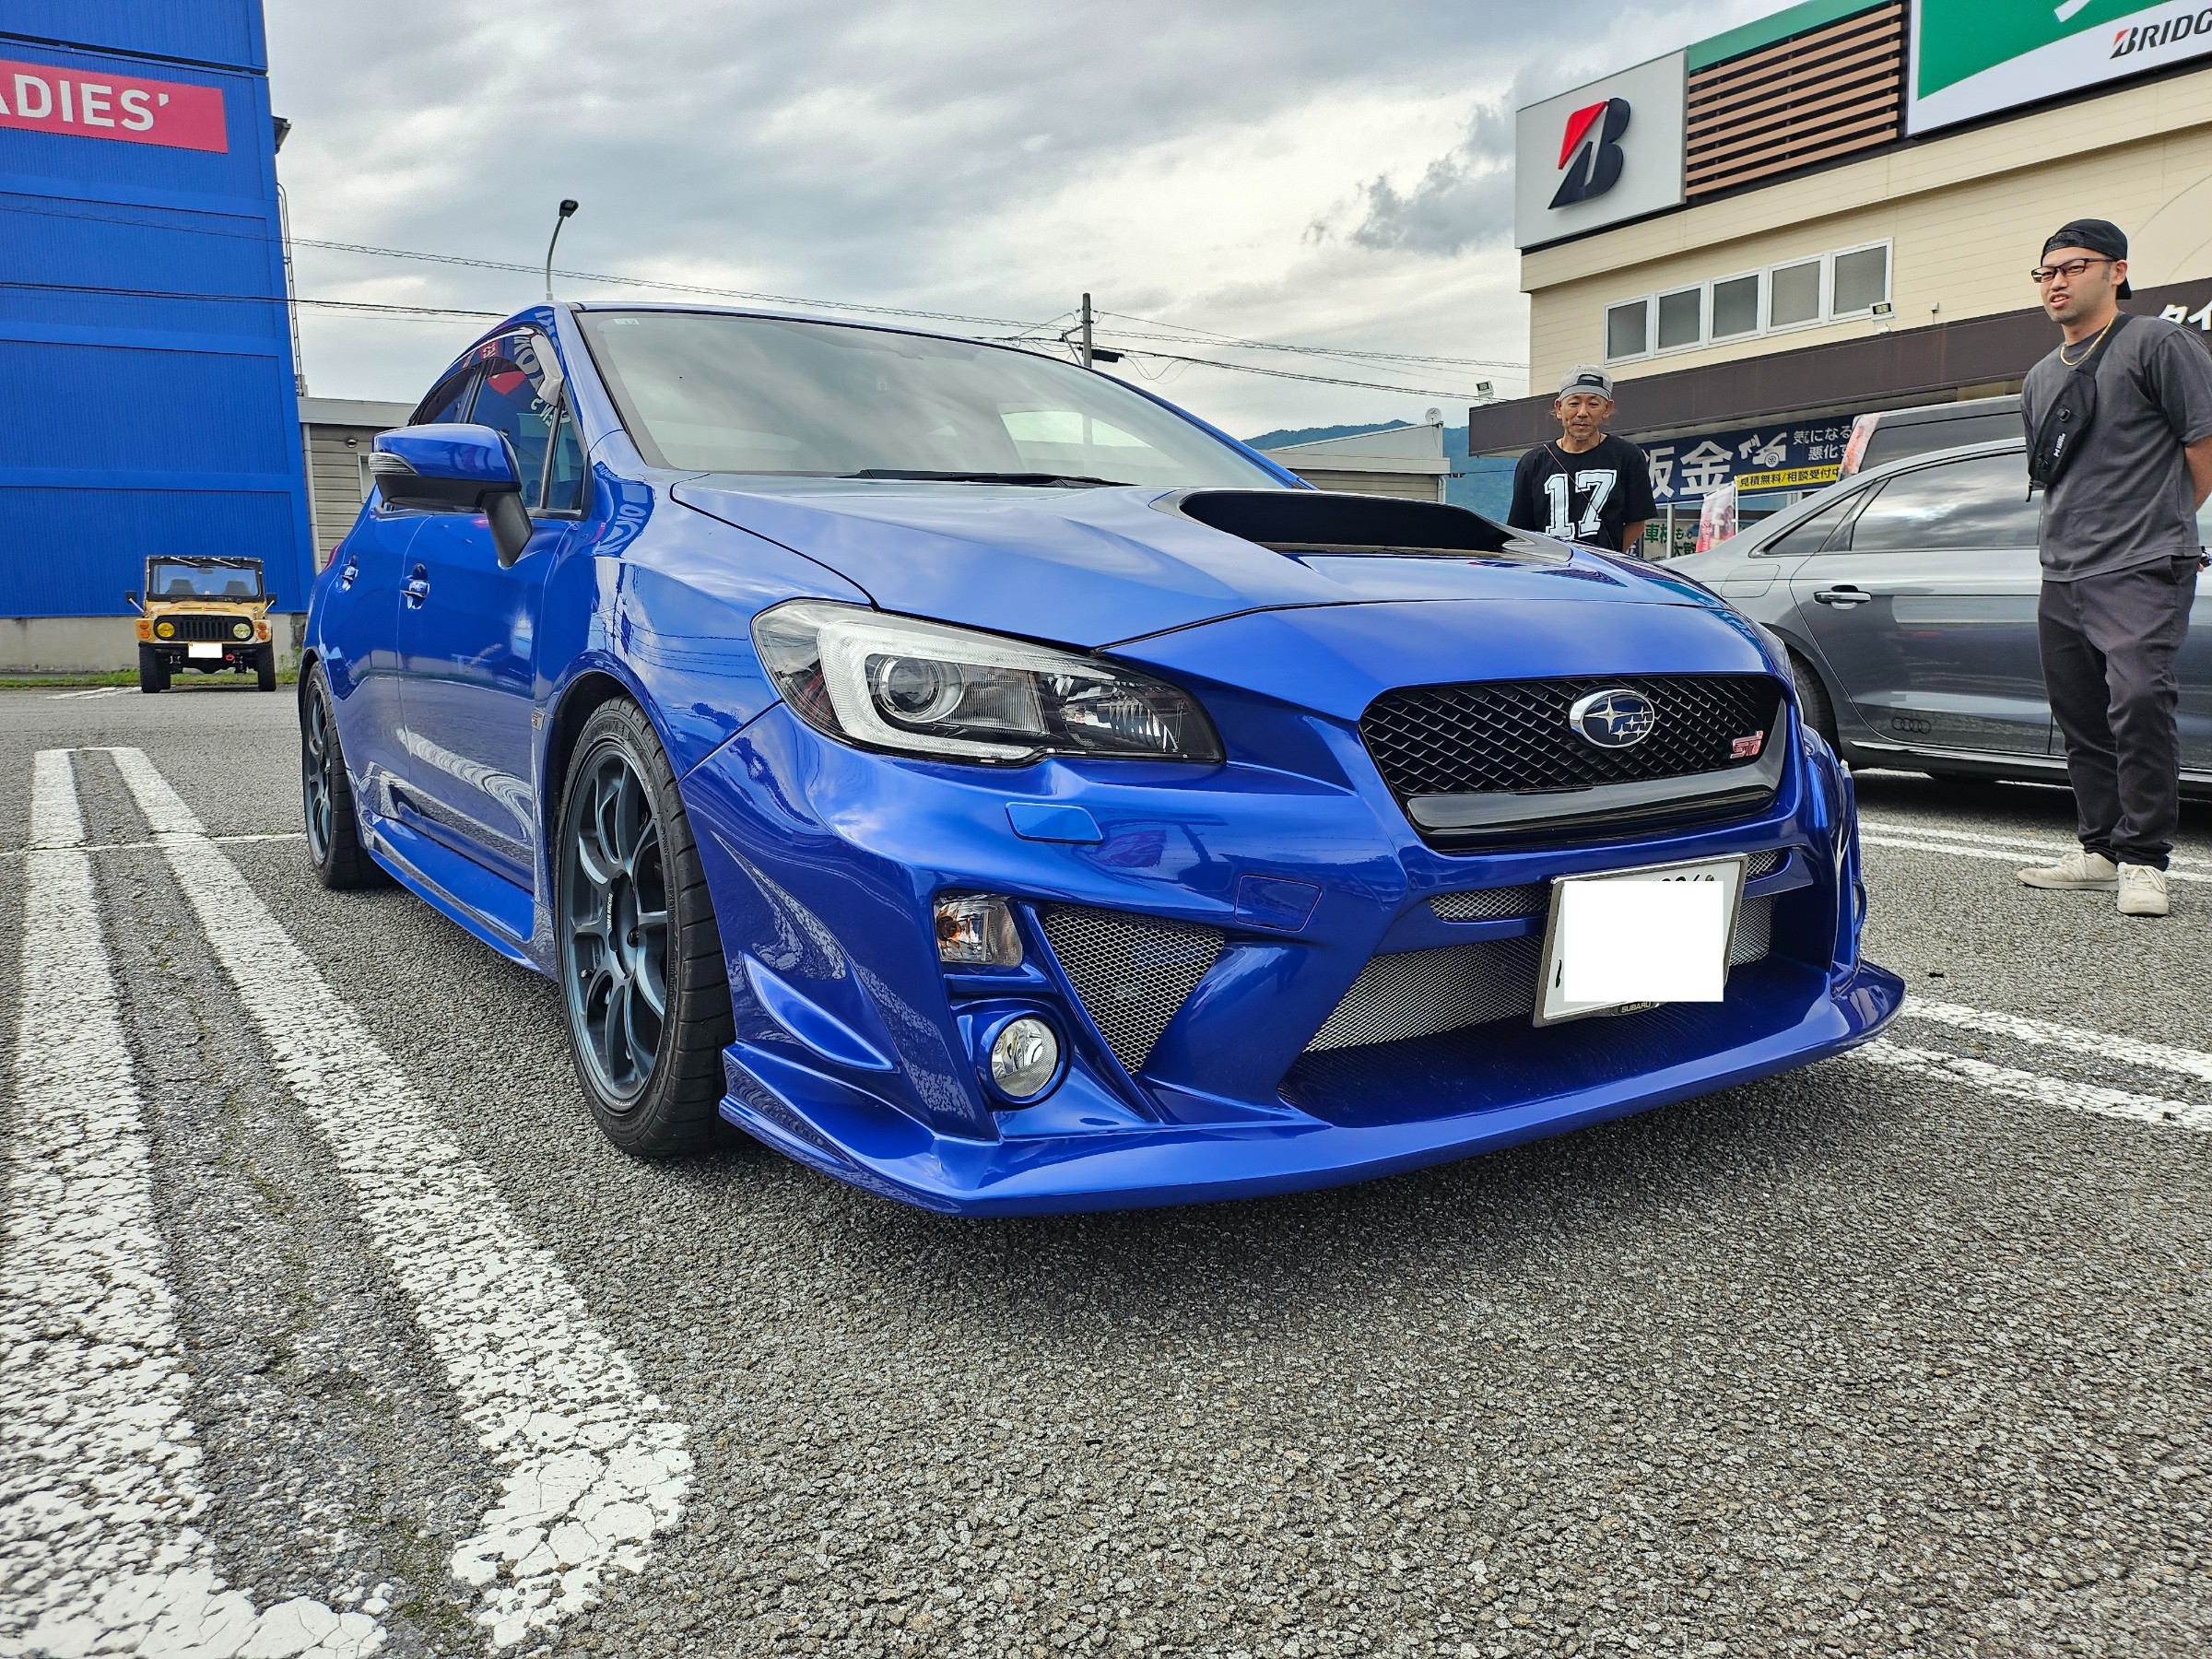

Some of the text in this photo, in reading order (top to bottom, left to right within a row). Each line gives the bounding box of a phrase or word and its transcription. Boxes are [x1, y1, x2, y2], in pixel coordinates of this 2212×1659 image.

[2109, 7, 2212, 60] BRIDG
[0, 73, 170, 132] DIES'
[1793, 425, 1852, 445] 気になる
[1543, 468, 1618, 541] 17
[1620, 1000, 1652, 1013] SUBARU
